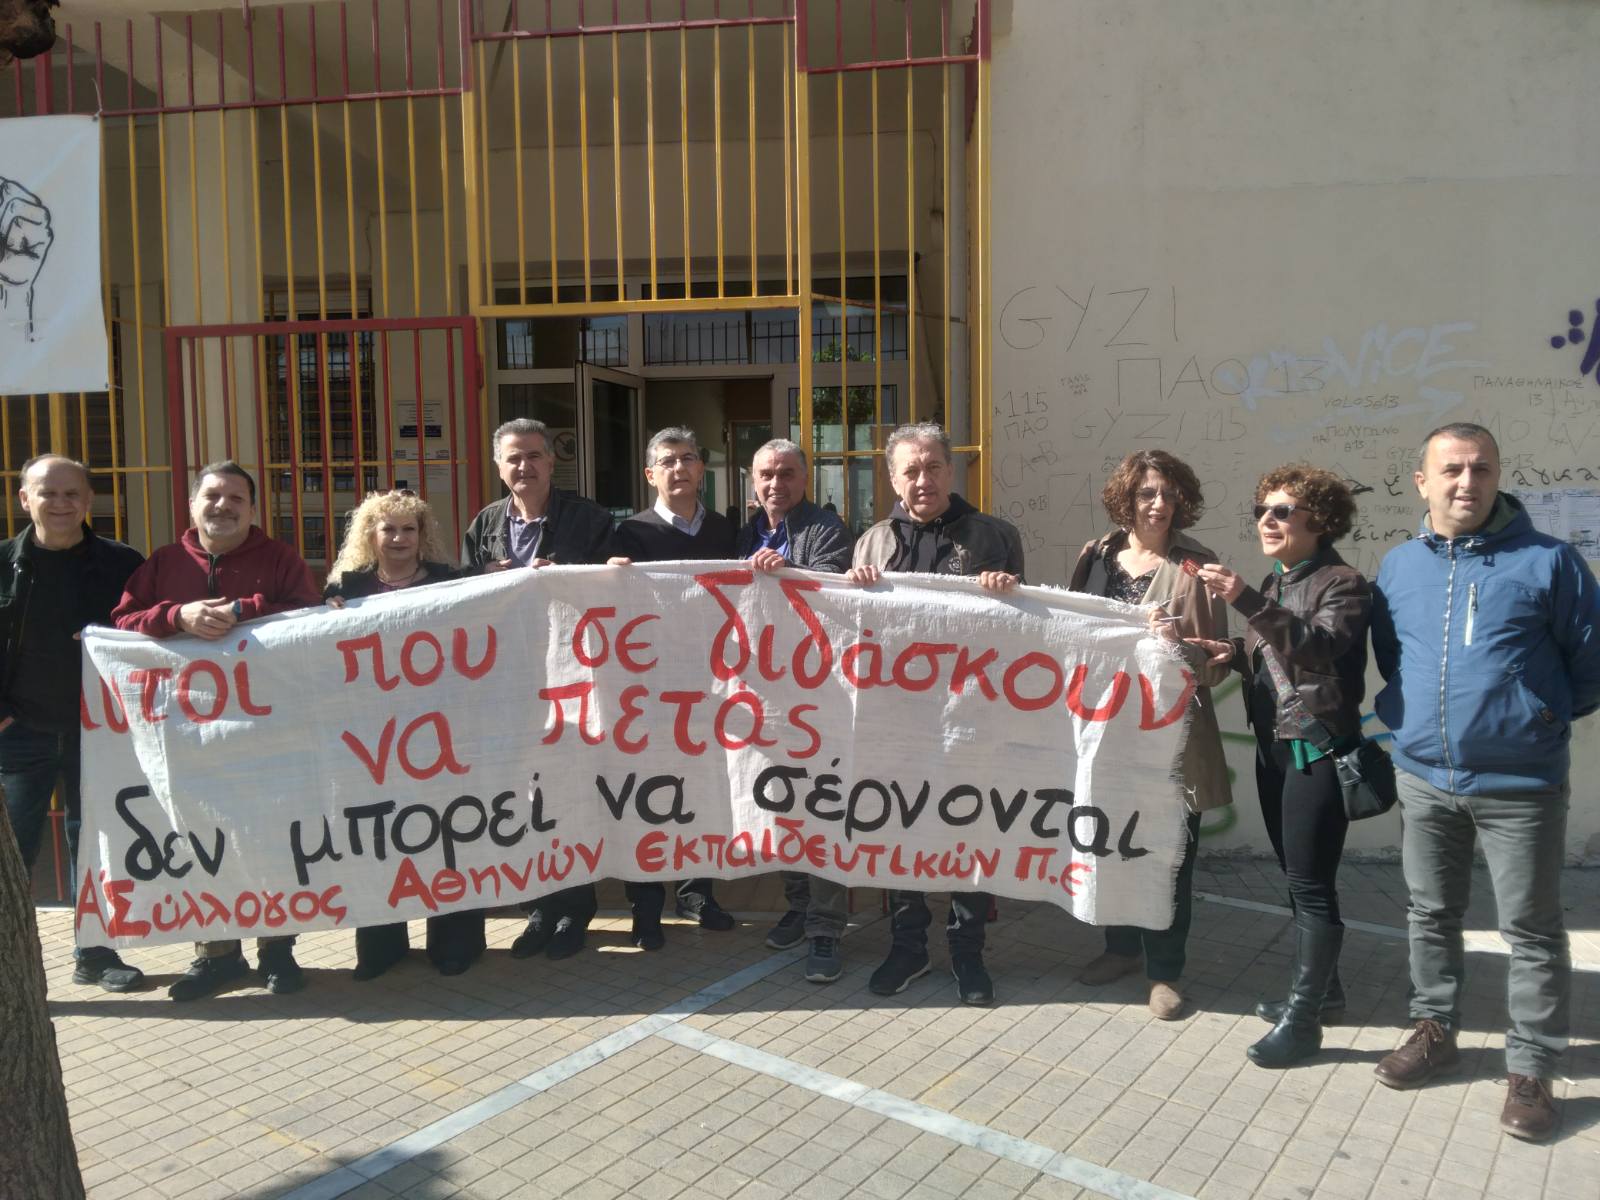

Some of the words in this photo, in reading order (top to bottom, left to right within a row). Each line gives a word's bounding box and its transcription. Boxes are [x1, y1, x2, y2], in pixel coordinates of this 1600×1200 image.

[999, 284, 1178, 352] GYZI
[1003, 416, 1049, 441] ΠΑΟ
[1116, 355, 1250, 406] ΠΑΟ
[1273, 359, 1329, 394] 13
[335, 622, 497, 692] που
[572, 606, 662, 673] σε
[694, 568, 1197, 731] διδάσκουν
[341, 711, 471, 786] να
[538, 679, 822, 759] πετάς
[114, 784, 226, 881] δεν
[289, 772, 558, 886] μπορεί
[595, 771, 696, 825] να
[752, 757, 1152, 861] σέρνονται
[103, 884, 348, 939] Σύλλογος
[386, 837, 605, 913] Αθηνών
[635, 816, 1001, 880] εκπαιδευτικών
